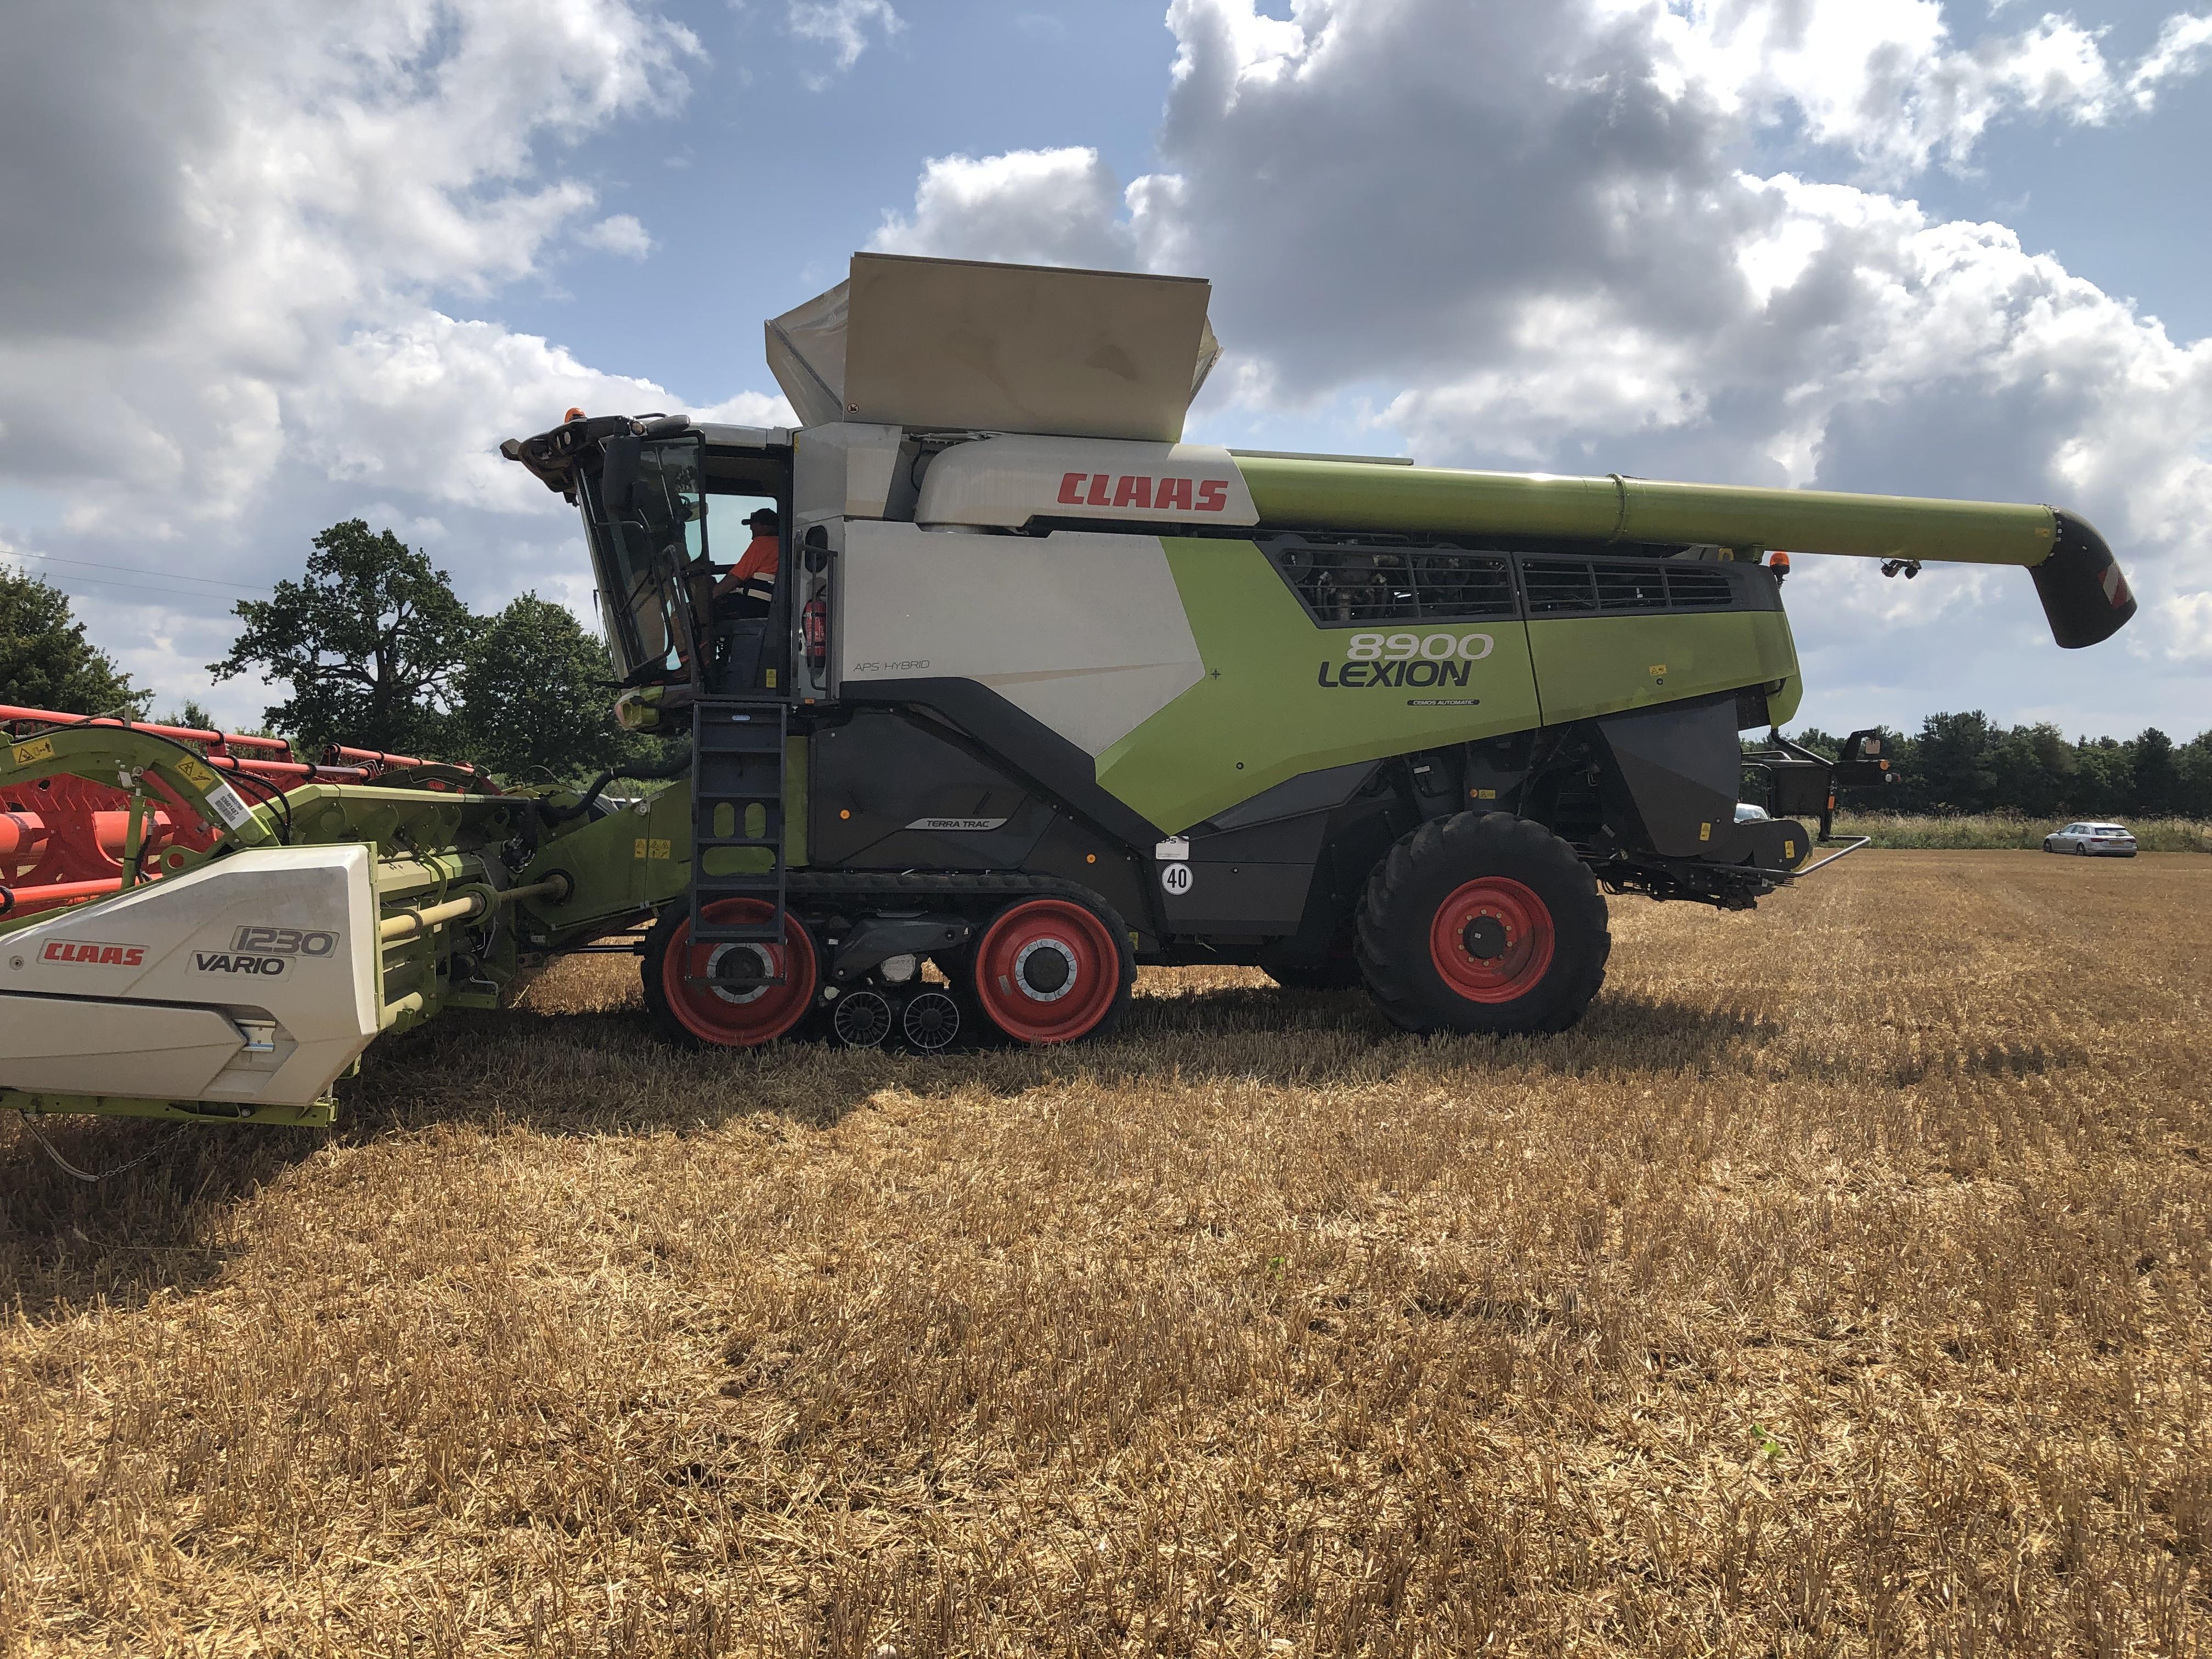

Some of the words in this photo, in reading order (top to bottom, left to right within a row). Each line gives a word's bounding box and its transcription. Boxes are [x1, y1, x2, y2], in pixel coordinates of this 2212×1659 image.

[1057, 473, 1229, 511] CLAAS
[1347, 634, 1494, 660] 8900
[853, 663, 879, 672] APS
[884, 660, 930, 670] HYBRID
[1318, 661, 1472, 687] LEXION
[1167, 868, 1187, 888] 40
[236, 928, 334, 955] 1230
[43, 943, 144, 966] CLAAS
[196, 953, 285, 975] VARIO
